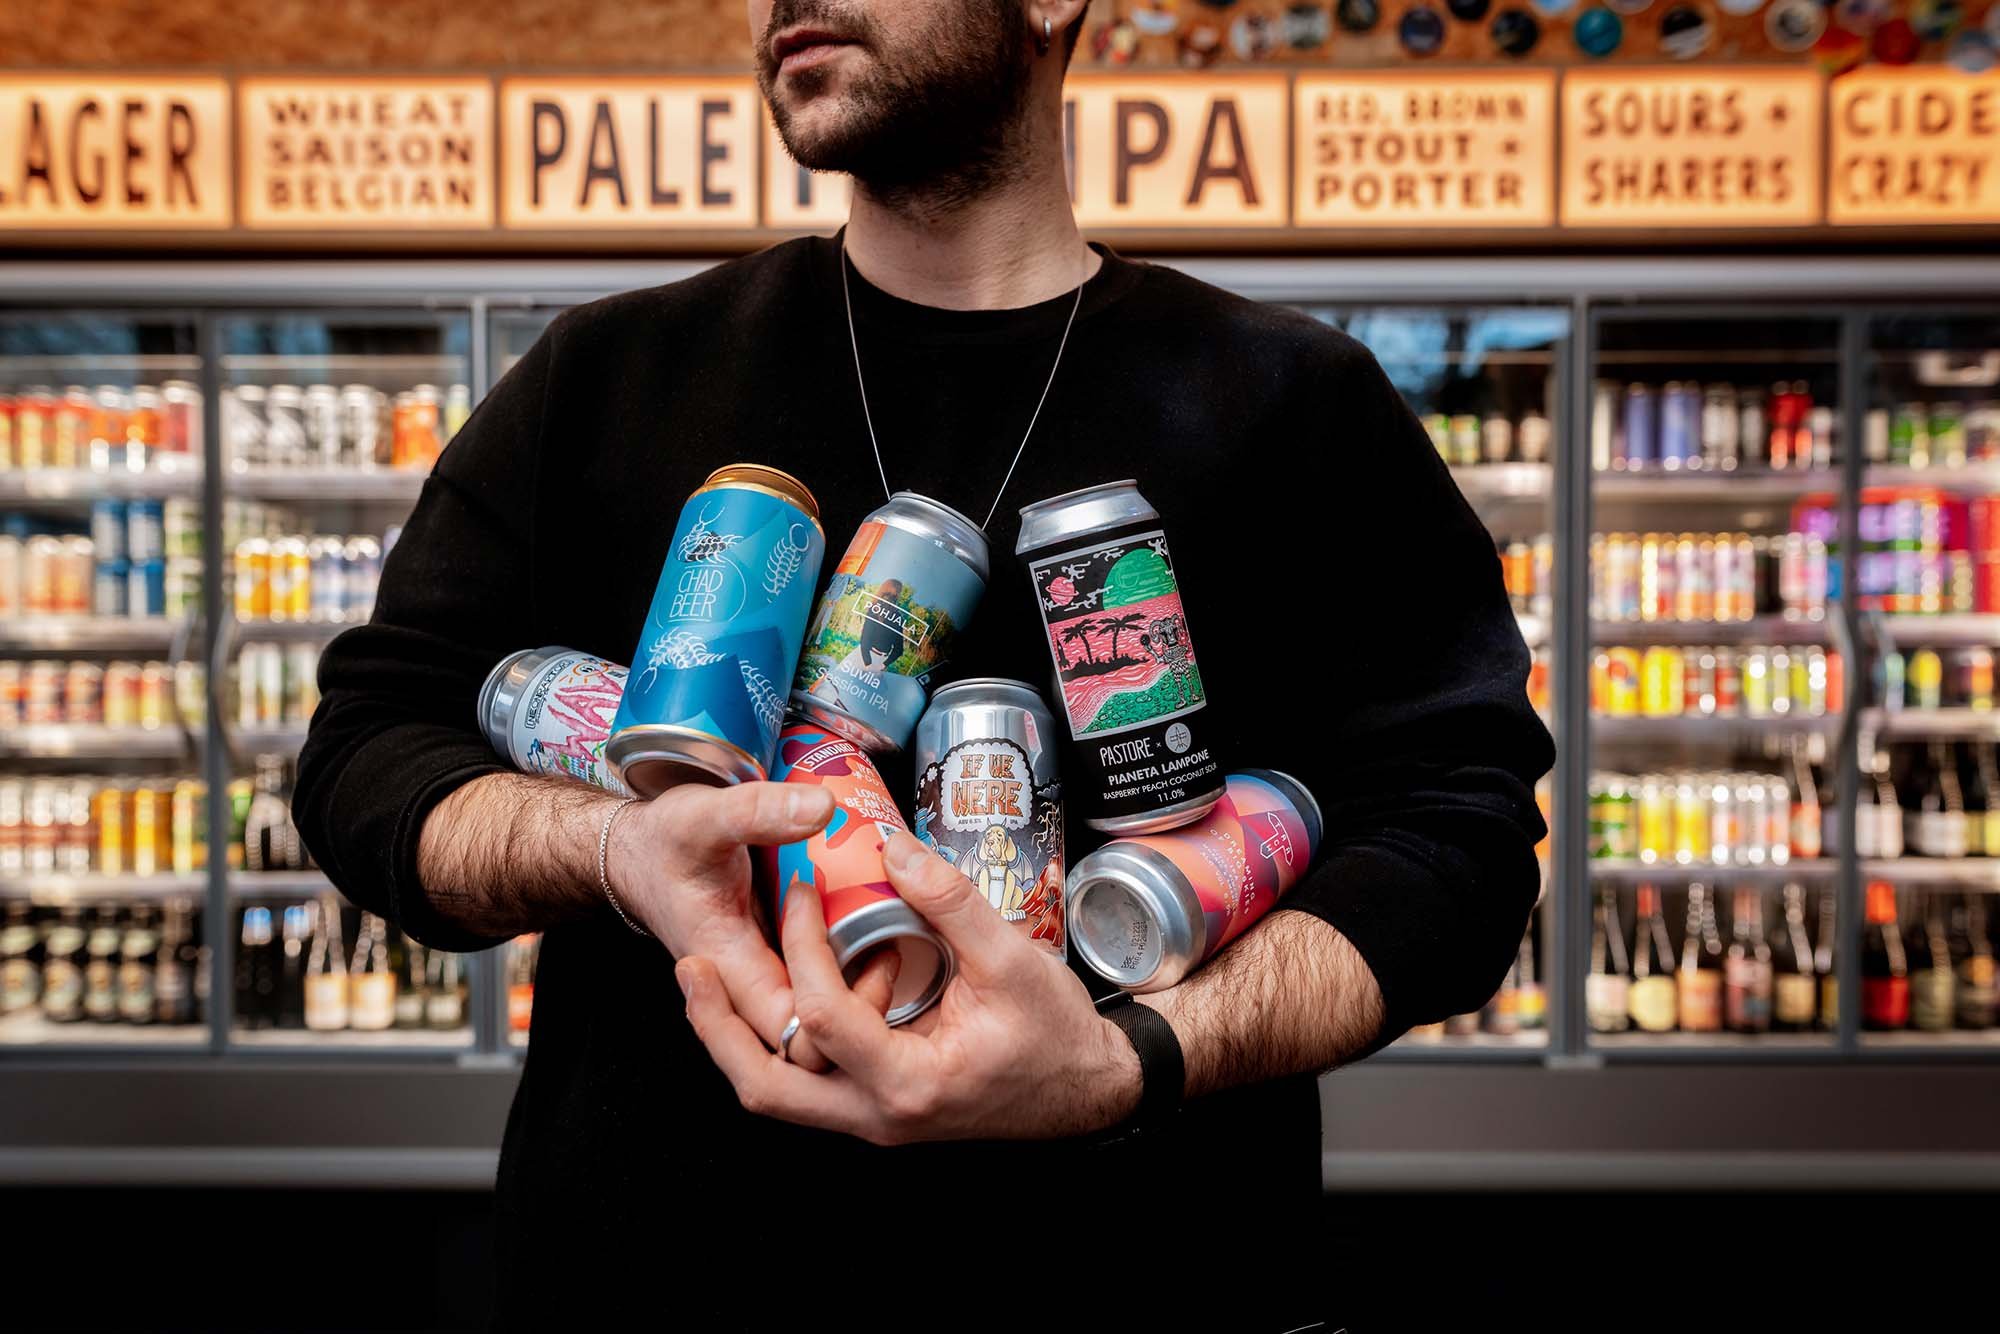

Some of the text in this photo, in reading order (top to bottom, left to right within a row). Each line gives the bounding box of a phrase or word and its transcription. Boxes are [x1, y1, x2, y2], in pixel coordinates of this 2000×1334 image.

[268, 95, 474, 126] WHEAT
[1584, 91, 1745, 139] SOURS
[0, 101, 198, 205] AGER
[268, 133, 474, 169] SAISON
[531, 100, 734, 207] PALE
[1317, 130, 1472, 165] STOUT
[267, 174, 474, 211] BELGIAN
[1316, 172, 1526, 210] PORTER
[1583, 156, 1793, 205] SHARERS
[1842, 153, 1992, 207] CRAZY
[678, 569, 723, 593] CHAD
[669, 593, 716, 618] BEER
[864, 600, 917, 636] PÕHJALA
[841, 661, 881, 689] Suvila
[868, 692, 890, 715] IPA
[804, 741, 856, 767] STANDARD
[960, 753, 1016, 779] IF WE
[1100, 737, 1154, 767] PASTORE
[1108, 749, 1210, 786] PIANETA LAMPONE
[951, 780, 1024, 818] WERE
[1103, 786, 1141, 801] RASPBERRY
[1142, 780, 1169, 793] PEACH
[1169, 768, 1205, 786] COCONUT
[1158, 788, 1186, 803] 11.0%
